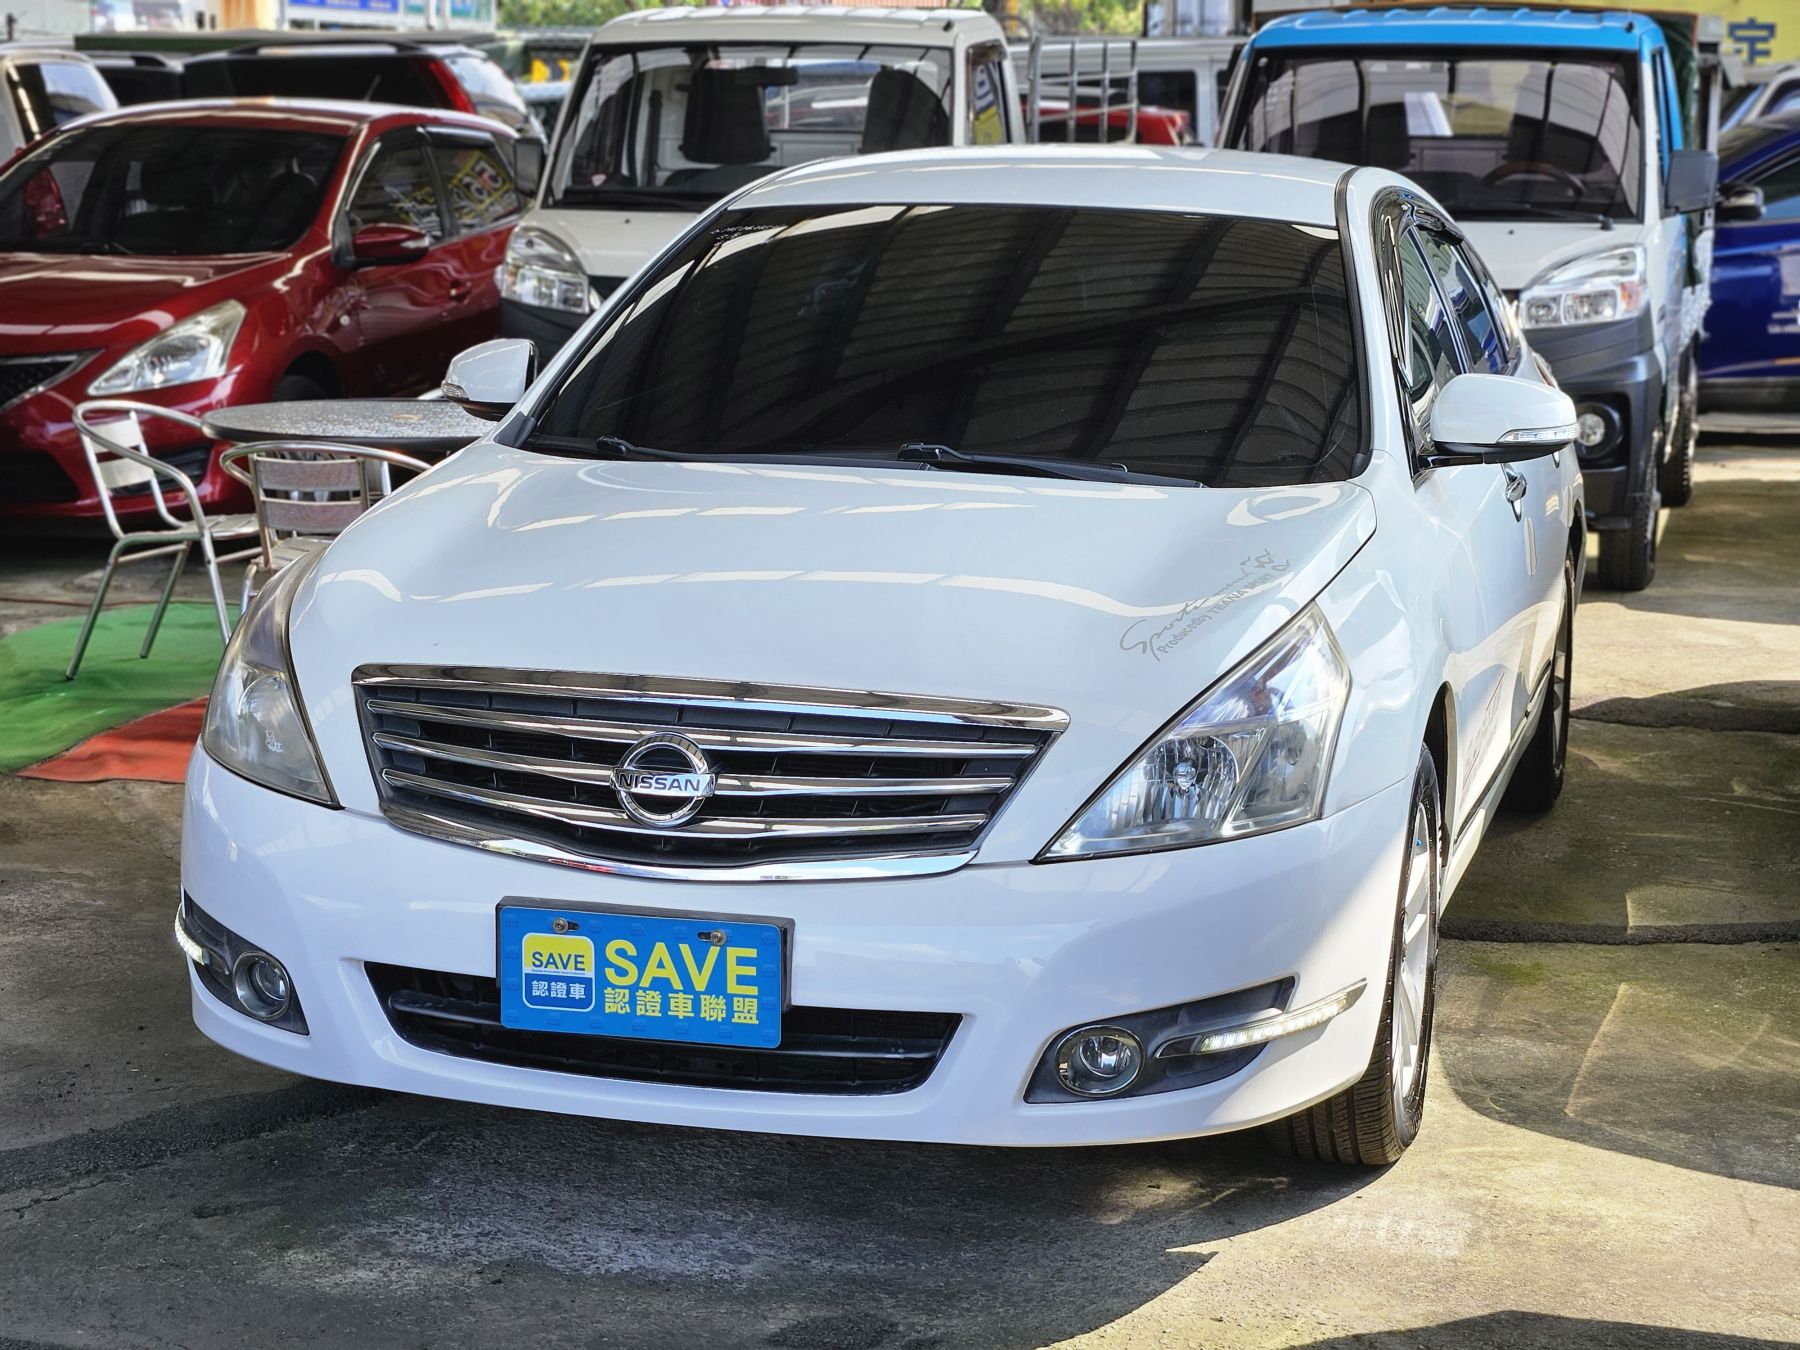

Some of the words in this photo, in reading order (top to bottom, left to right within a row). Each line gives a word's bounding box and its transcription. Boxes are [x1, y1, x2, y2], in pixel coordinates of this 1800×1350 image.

[1207, 589, 1249, 615] TEANA
[618, 773, 701, 792] NISSAN
[531, 951, 586, 971] SAVE
[603, 939, 759, 995] SAVE
[531, 980, 586, 1000] 認證車
[603, 987, 759, 1025] 認證車聯盟
